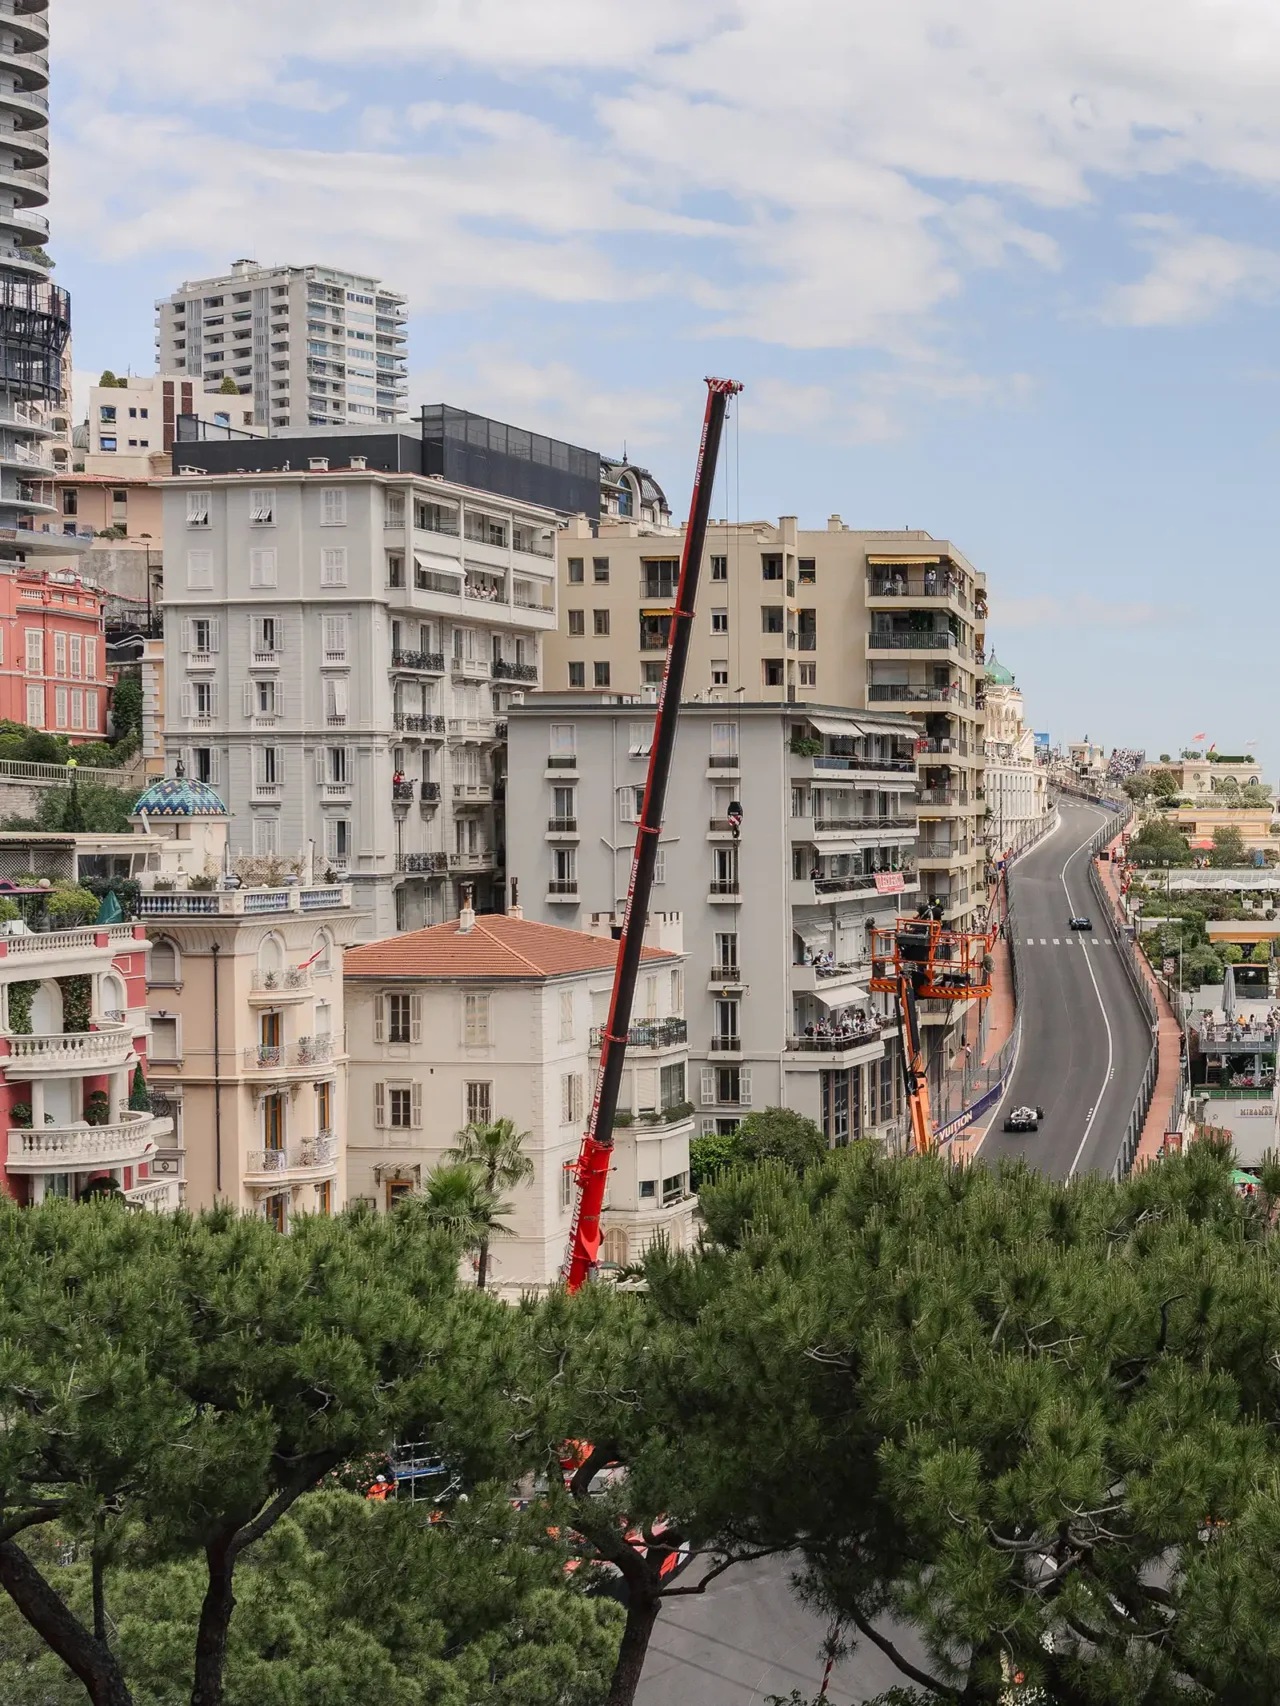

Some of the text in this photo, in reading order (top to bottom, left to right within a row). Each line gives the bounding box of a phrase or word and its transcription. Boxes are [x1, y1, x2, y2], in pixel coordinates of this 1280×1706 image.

[658, 644, 674, 713] IMPERIAL LEVAGE
[621, 858, 640, 936] IMPERIAL LEVAGE
[594, 1065, 606, 1104] LEVAGE
[938, 1110, 973, 1141] VUITTON
[571, 1185, 584, 1237] LEVAGE
